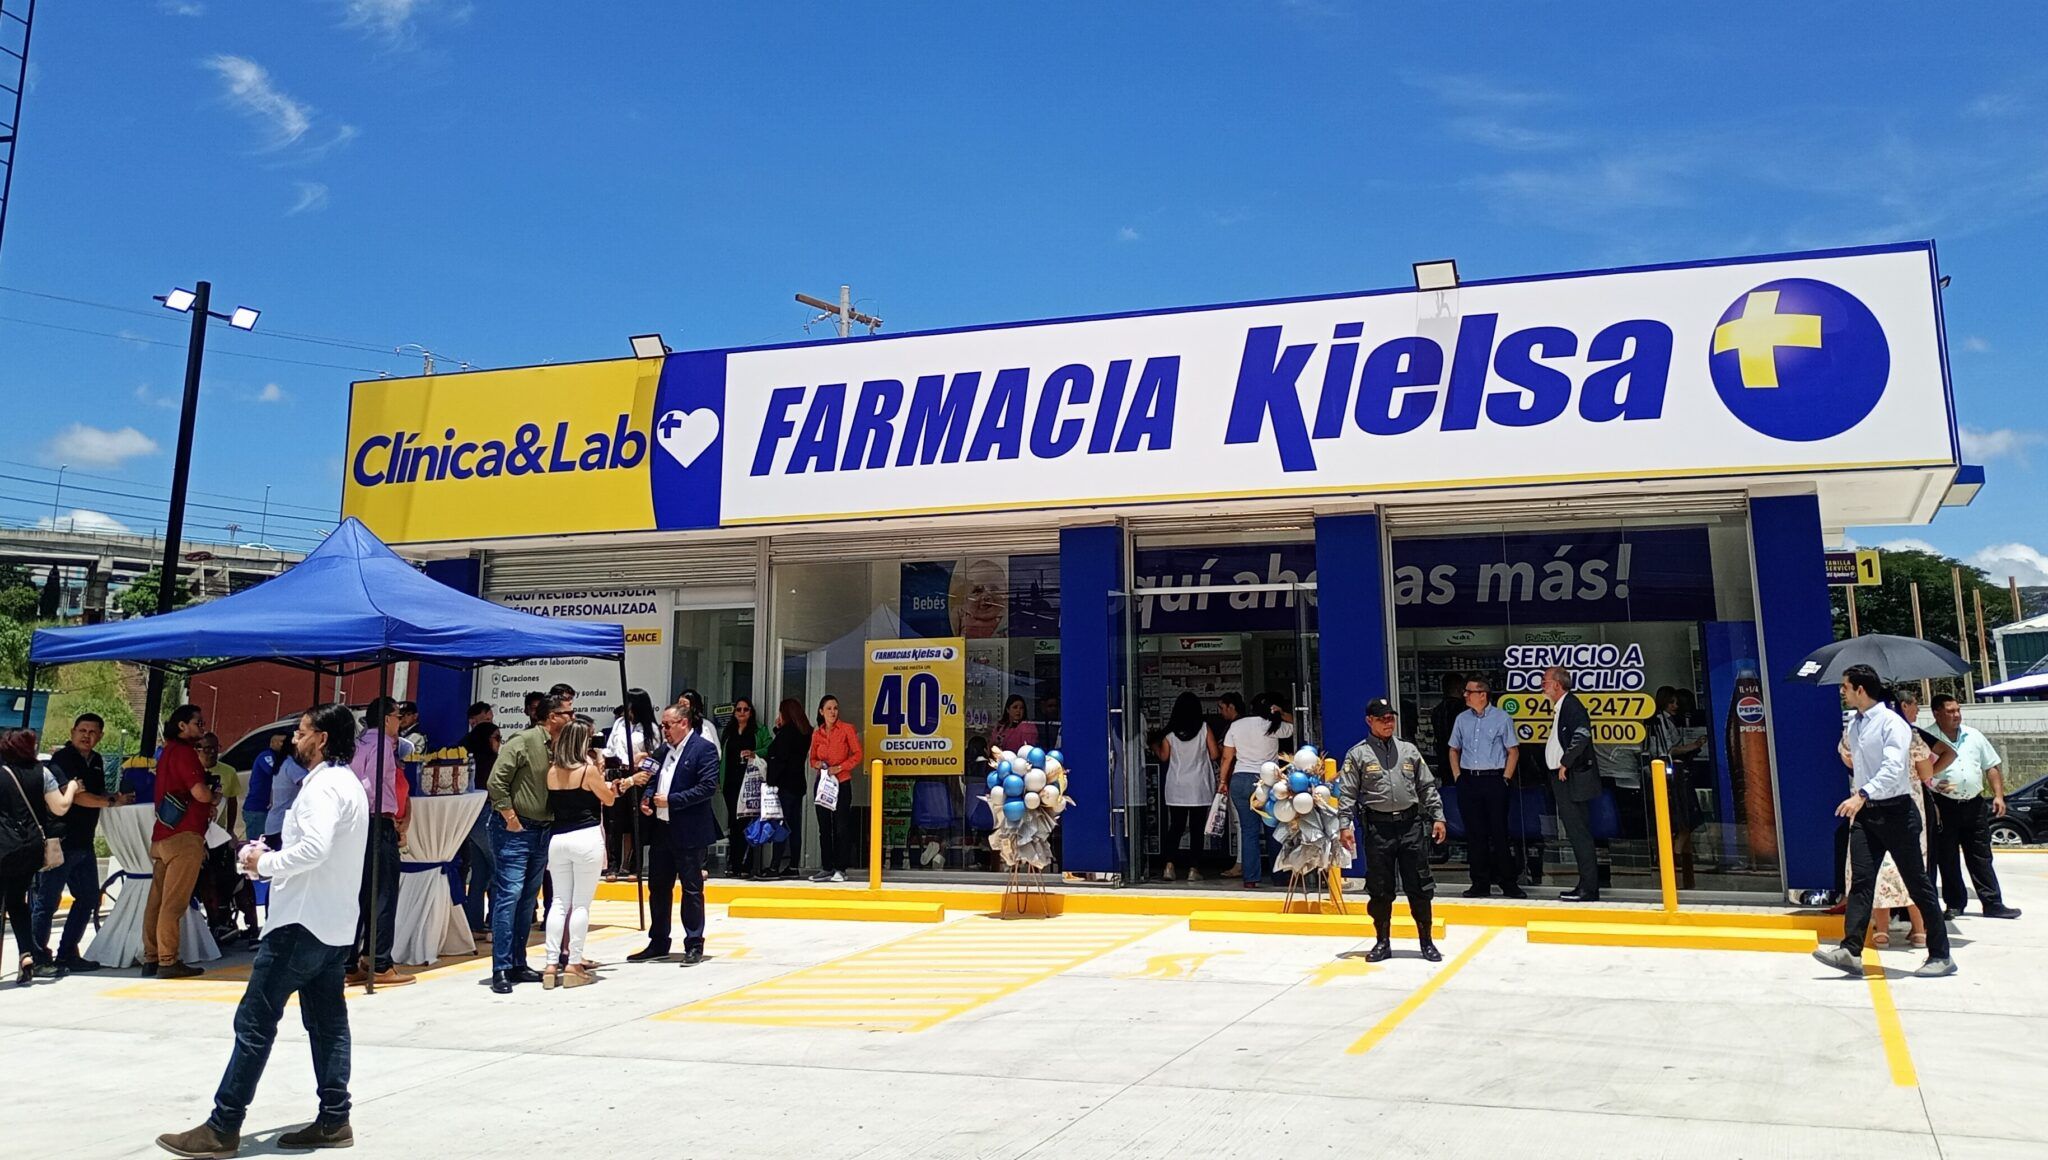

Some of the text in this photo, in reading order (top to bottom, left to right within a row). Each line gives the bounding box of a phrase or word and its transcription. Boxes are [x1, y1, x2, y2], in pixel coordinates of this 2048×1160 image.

[750, 354, 1181, 477] FARMACIA
[352, 414, 649, 487] Clínica&Lab
[1861, 558, 1874, 578] 1
[1136, 558, 1219, 629] quí
[1476, 544, 1632, 603] más!
[913, 595, 946, 610] Bebés
[509, 602, 657, 617] ÉDICA PERSONALIZADA
[625, 633, 657, 643] CANCE
[549, 657, 588, 666] laboratorio
[875, 650, 911, 660] FARMACIAS
[1505, 645, 1643, 667] SERVICIO A
[501, 674, 540, 683] Curaciones
[1507, 669, 1644, 690] DOICILIO
[500, 689, 521, 698] Retiro
[581, 689, 607, 697] sondas
[499, 705, 525, 714] Certific
[590, 705, 615, 714] matrim
[872, 672, 958, 736] 40%
[1524, 697, 1645, 717] 94-2477
[498, 722, 523, 730] Lavado
[1739, 725, 1766, 733] PEPSI
[886, 740, 946, 751] DESCUENTO
[894, 758, 919, 766] TODO
[920, 756, 958, 766] PÚBLICO
